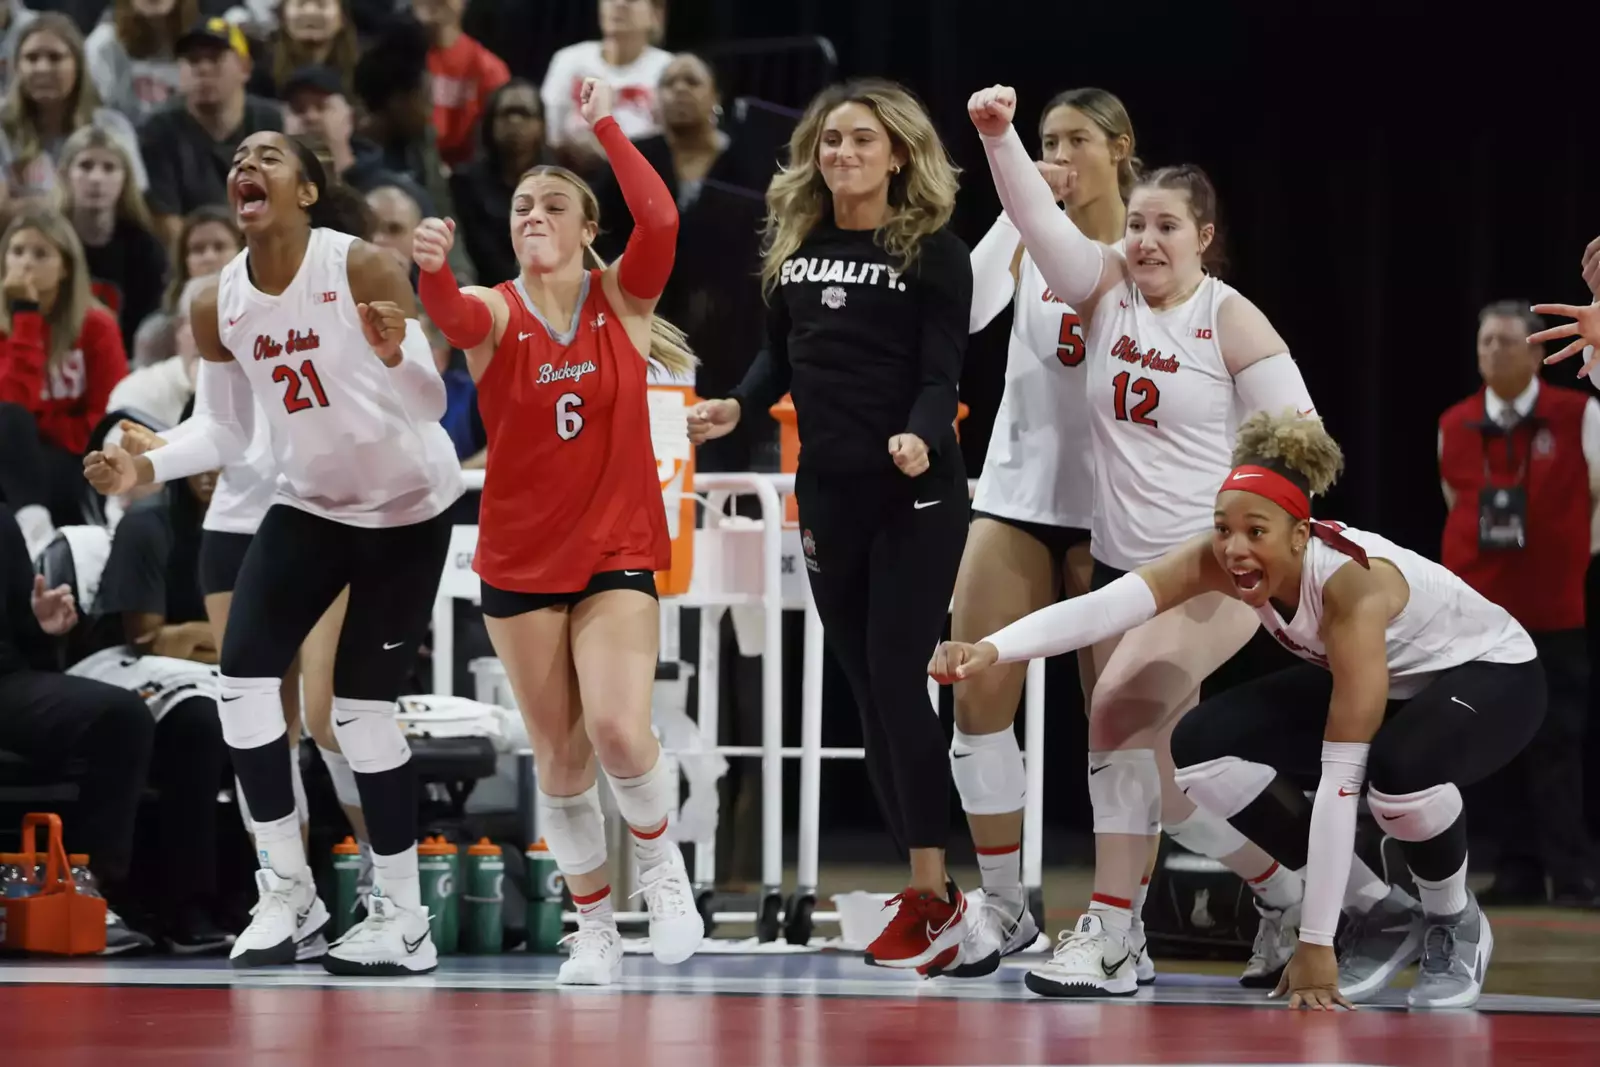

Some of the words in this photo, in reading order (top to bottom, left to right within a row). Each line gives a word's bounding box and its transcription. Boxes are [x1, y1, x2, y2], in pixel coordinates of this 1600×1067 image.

[780, 257, 906, 292] EQUALITY.
[1056, 312, 1087, 367] 5
[271, 359, 330, 414] 21
[535, 360, 597, 384] Buckeyes
[555, 391, 584, 441] 6
[1112, 371, 1160, 429] 12
